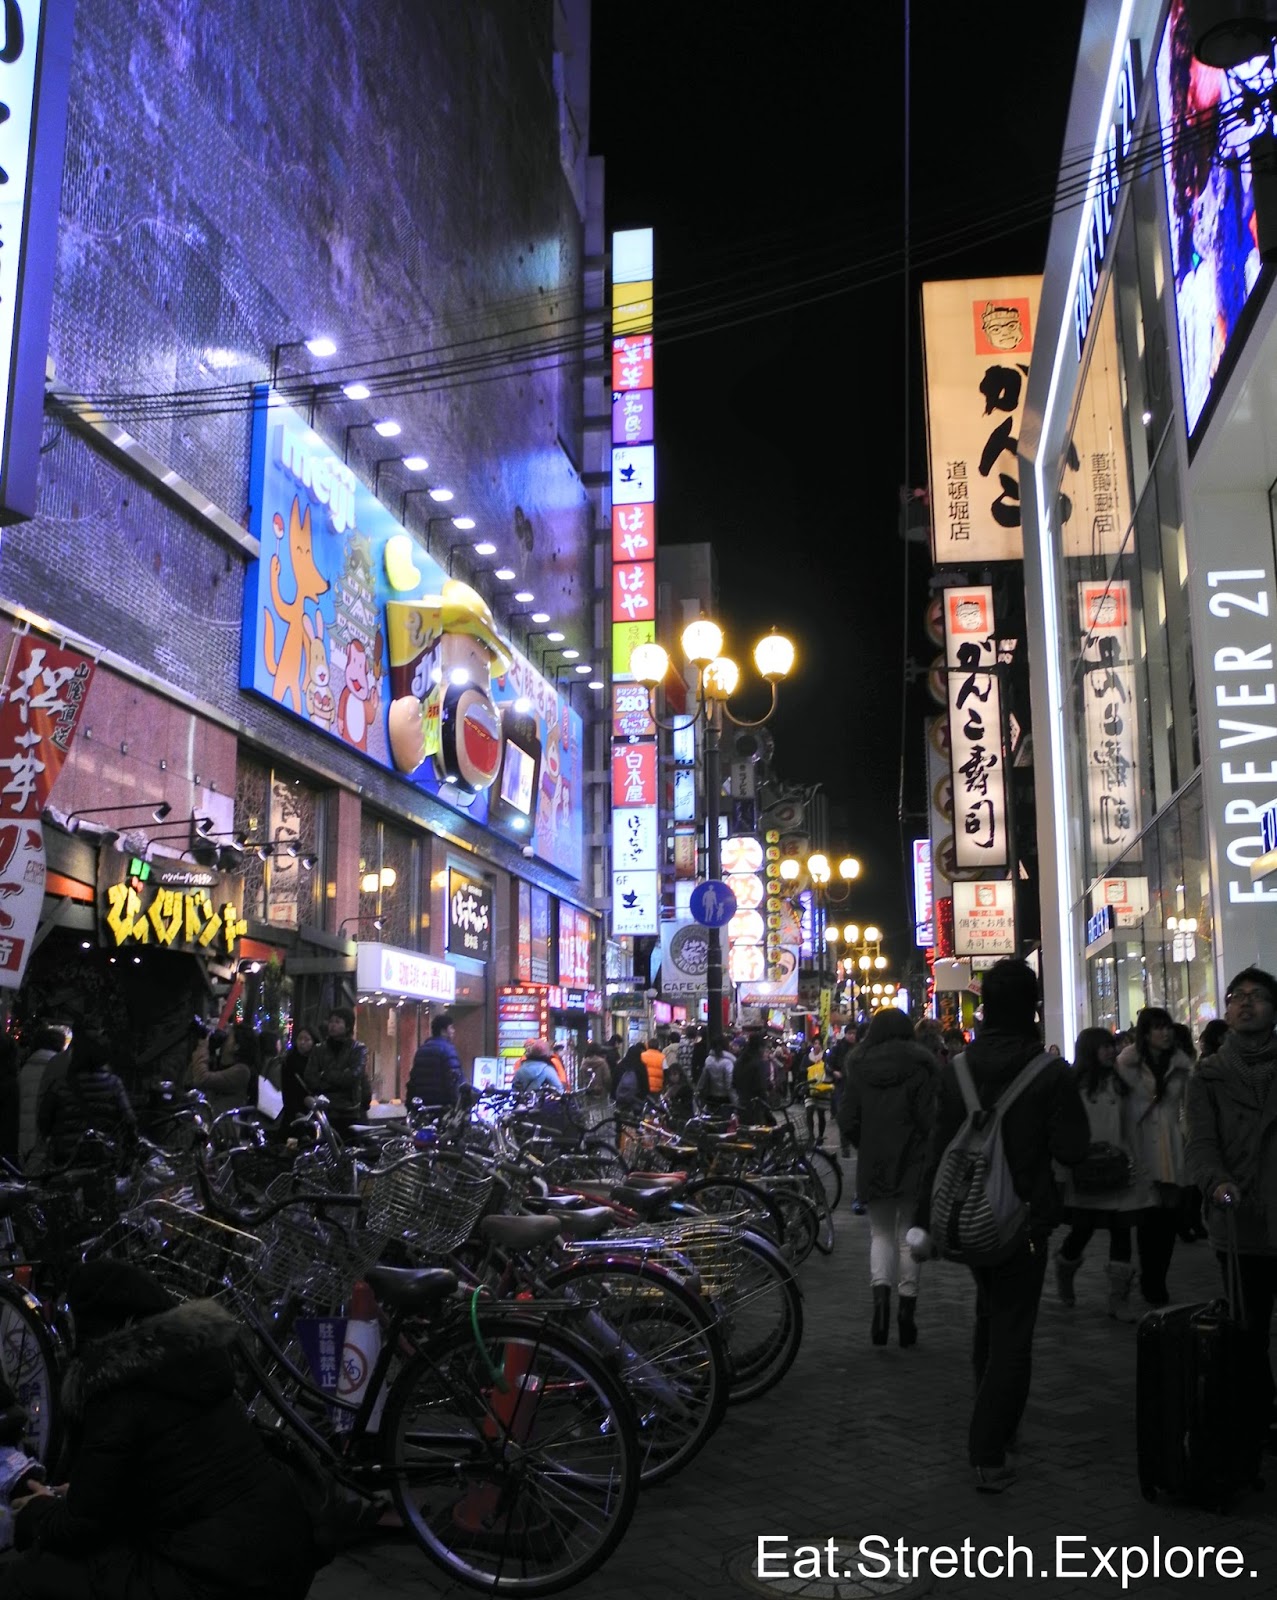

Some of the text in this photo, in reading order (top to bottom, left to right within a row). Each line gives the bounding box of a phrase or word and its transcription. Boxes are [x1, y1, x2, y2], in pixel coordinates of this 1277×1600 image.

[947, 460, 970, 541] 道頓堀店
[618, 506, 649, 558] はや
[618, 565, 649, 618] はや
[1207, 569, 1269, 619] 21
[49, 662, 90, 752] 山陰直送
[614, 747, 627, 757] 2F
[624, 751, 646, 803] 白木屋
[616, 876, 628, 886] 6F
[663, 982, 694, 992] CAFE
[318, 1322, 337, 1388] 駐輪禁止
